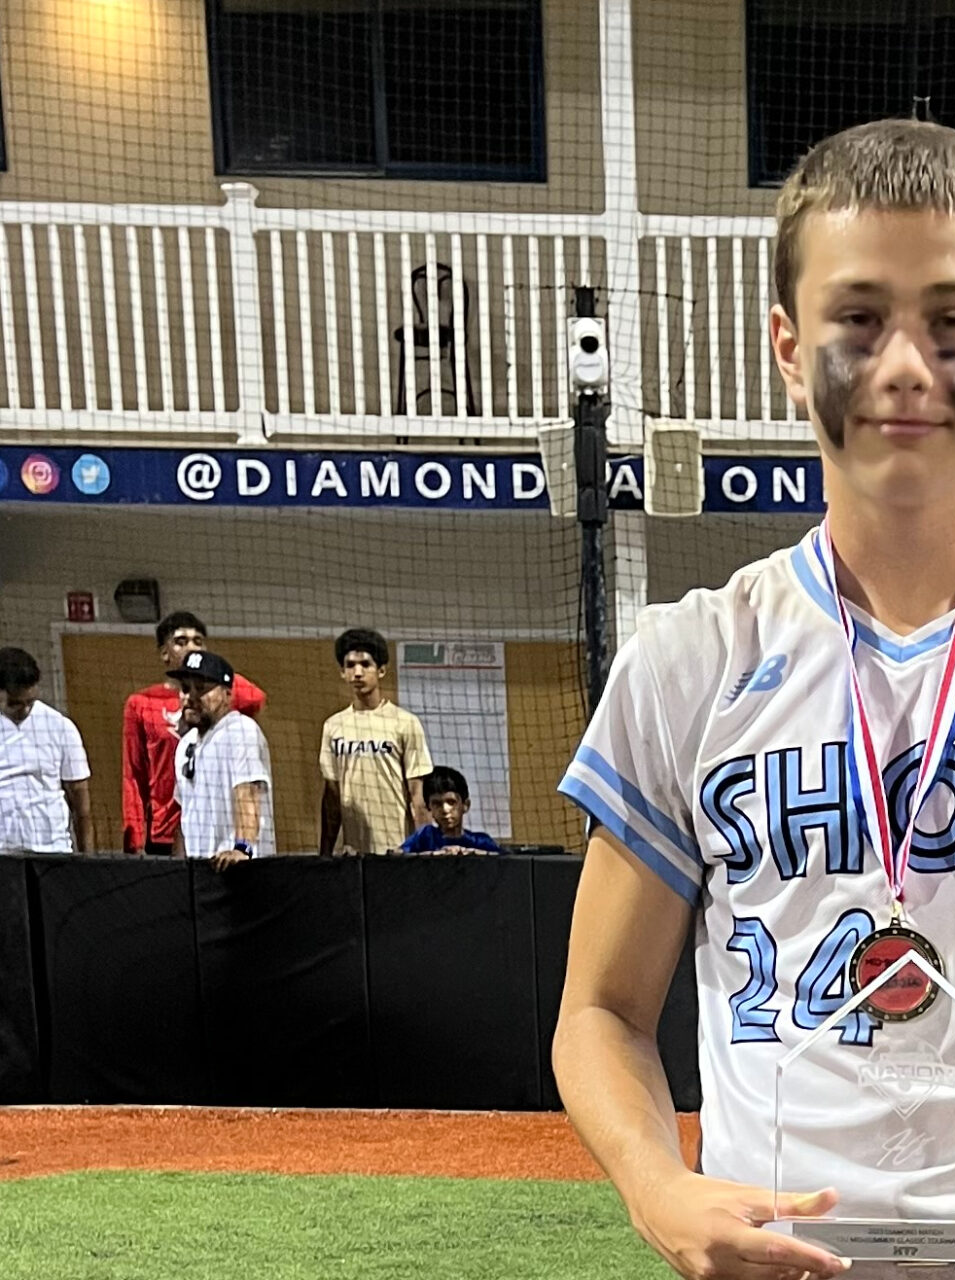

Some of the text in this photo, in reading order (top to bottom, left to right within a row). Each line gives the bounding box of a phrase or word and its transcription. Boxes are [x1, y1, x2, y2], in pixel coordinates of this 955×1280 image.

[177, 453, 828, 504] @DIAMONDAON
[332, 737, 395, 758] TITANS
[726, 908, 883, 1046] 24
